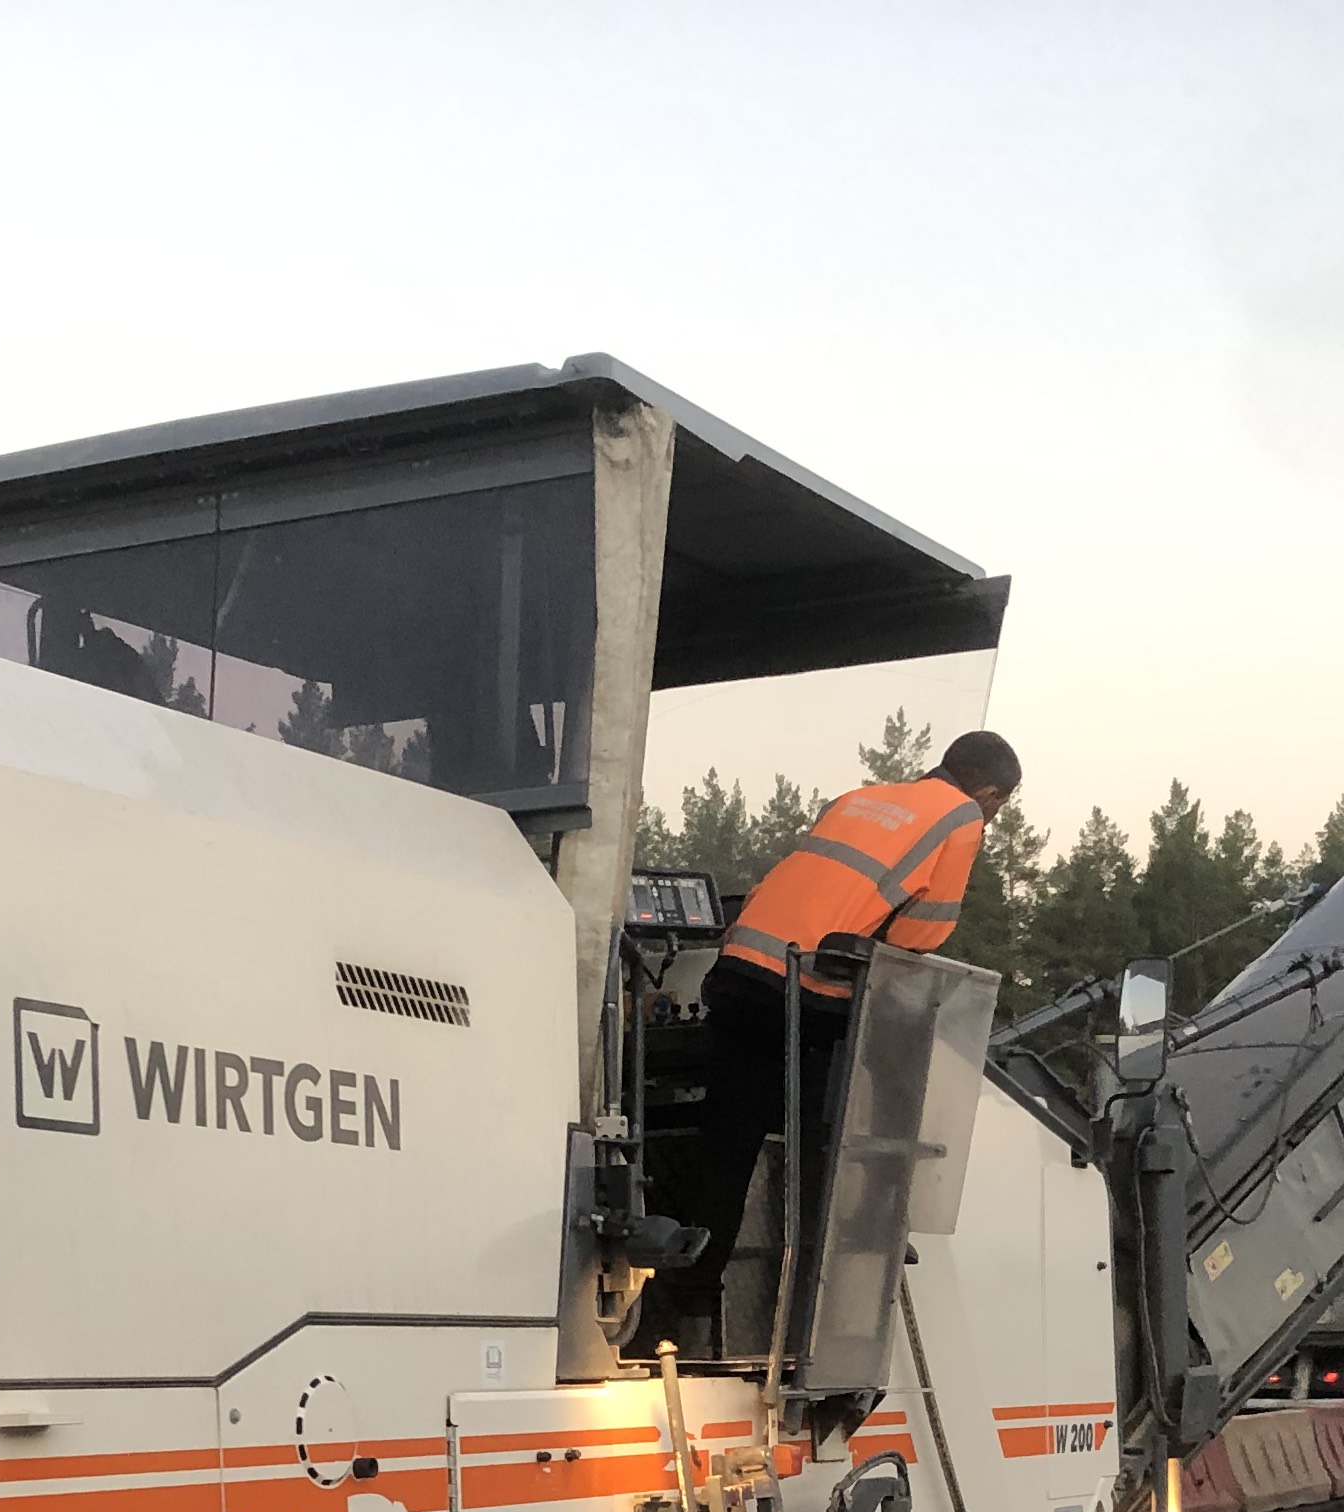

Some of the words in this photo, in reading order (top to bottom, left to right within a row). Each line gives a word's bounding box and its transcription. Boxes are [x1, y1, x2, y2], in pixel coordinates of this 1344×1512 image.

[26, 1031, 87, 1102] W
[123, 1035, 402, 1152] WIRTGEN
[1056, 1424, 1068, 1454] W
[1070, 1423, 1093, 1453] 200
